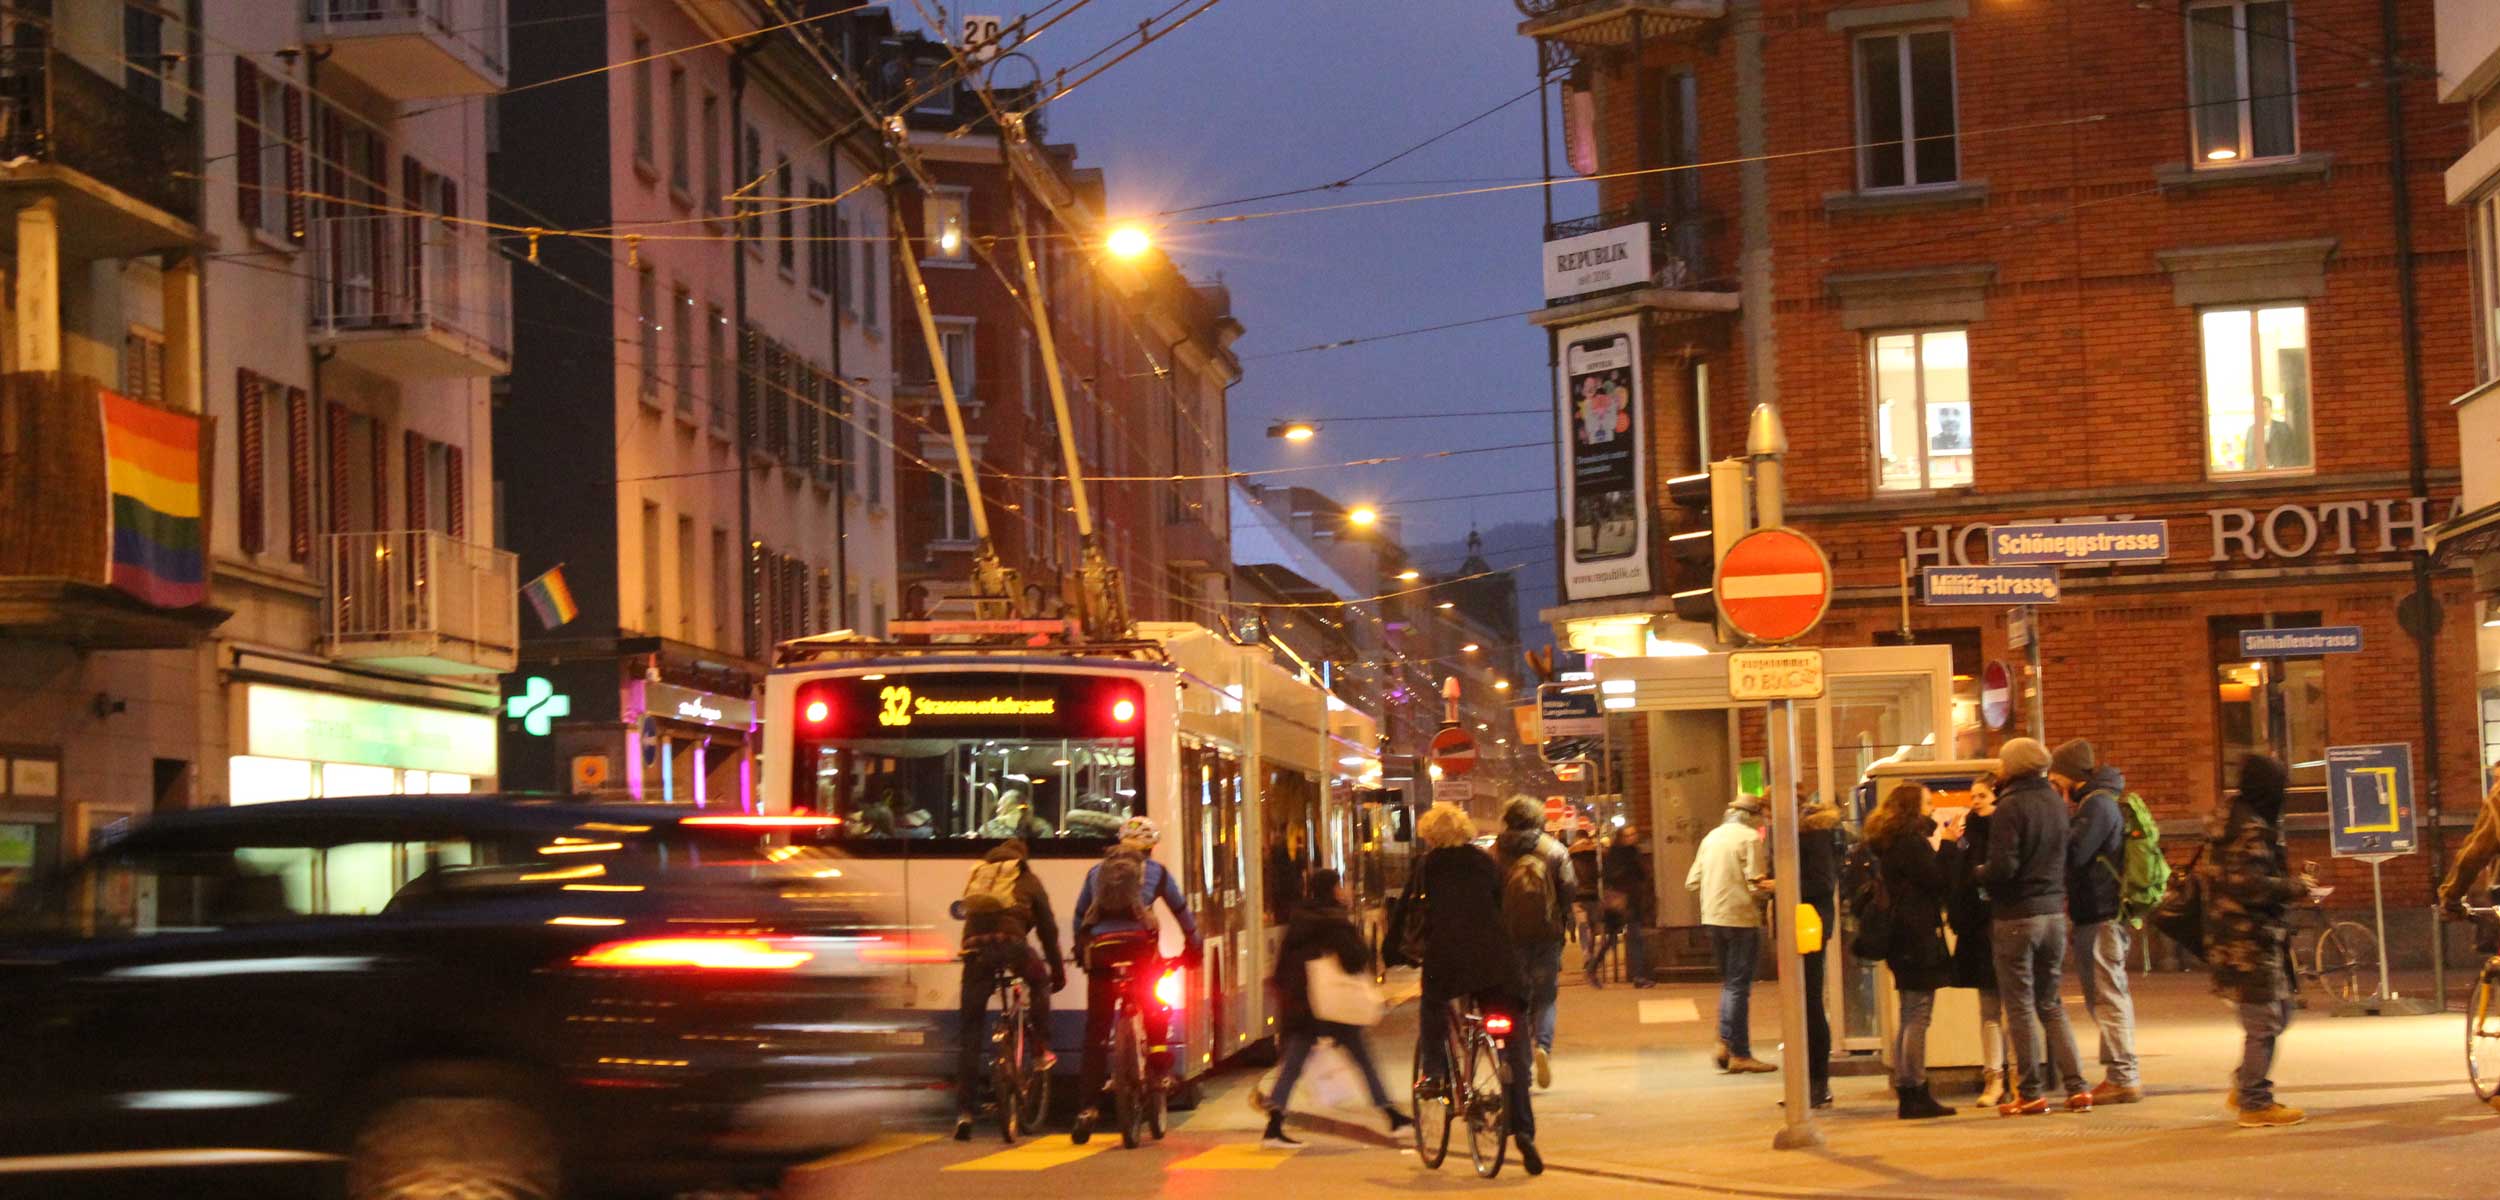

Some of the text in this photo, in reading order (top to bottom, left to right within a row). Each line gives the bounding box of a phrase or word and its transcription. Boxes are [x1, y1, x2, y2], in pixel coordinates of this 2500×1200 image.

[1557, 242, 1629, 273] REPUBLIK
[2207, 497, 2463, 562] ROTH
[1997, 532, 2160, 557] Schöneggstrasse
[1930, 573, 2058, 599] Militärstrasse
[2245, 633, 2357, 650] Sihlhallenstrasse
[879, 685, 911, 726] 32
